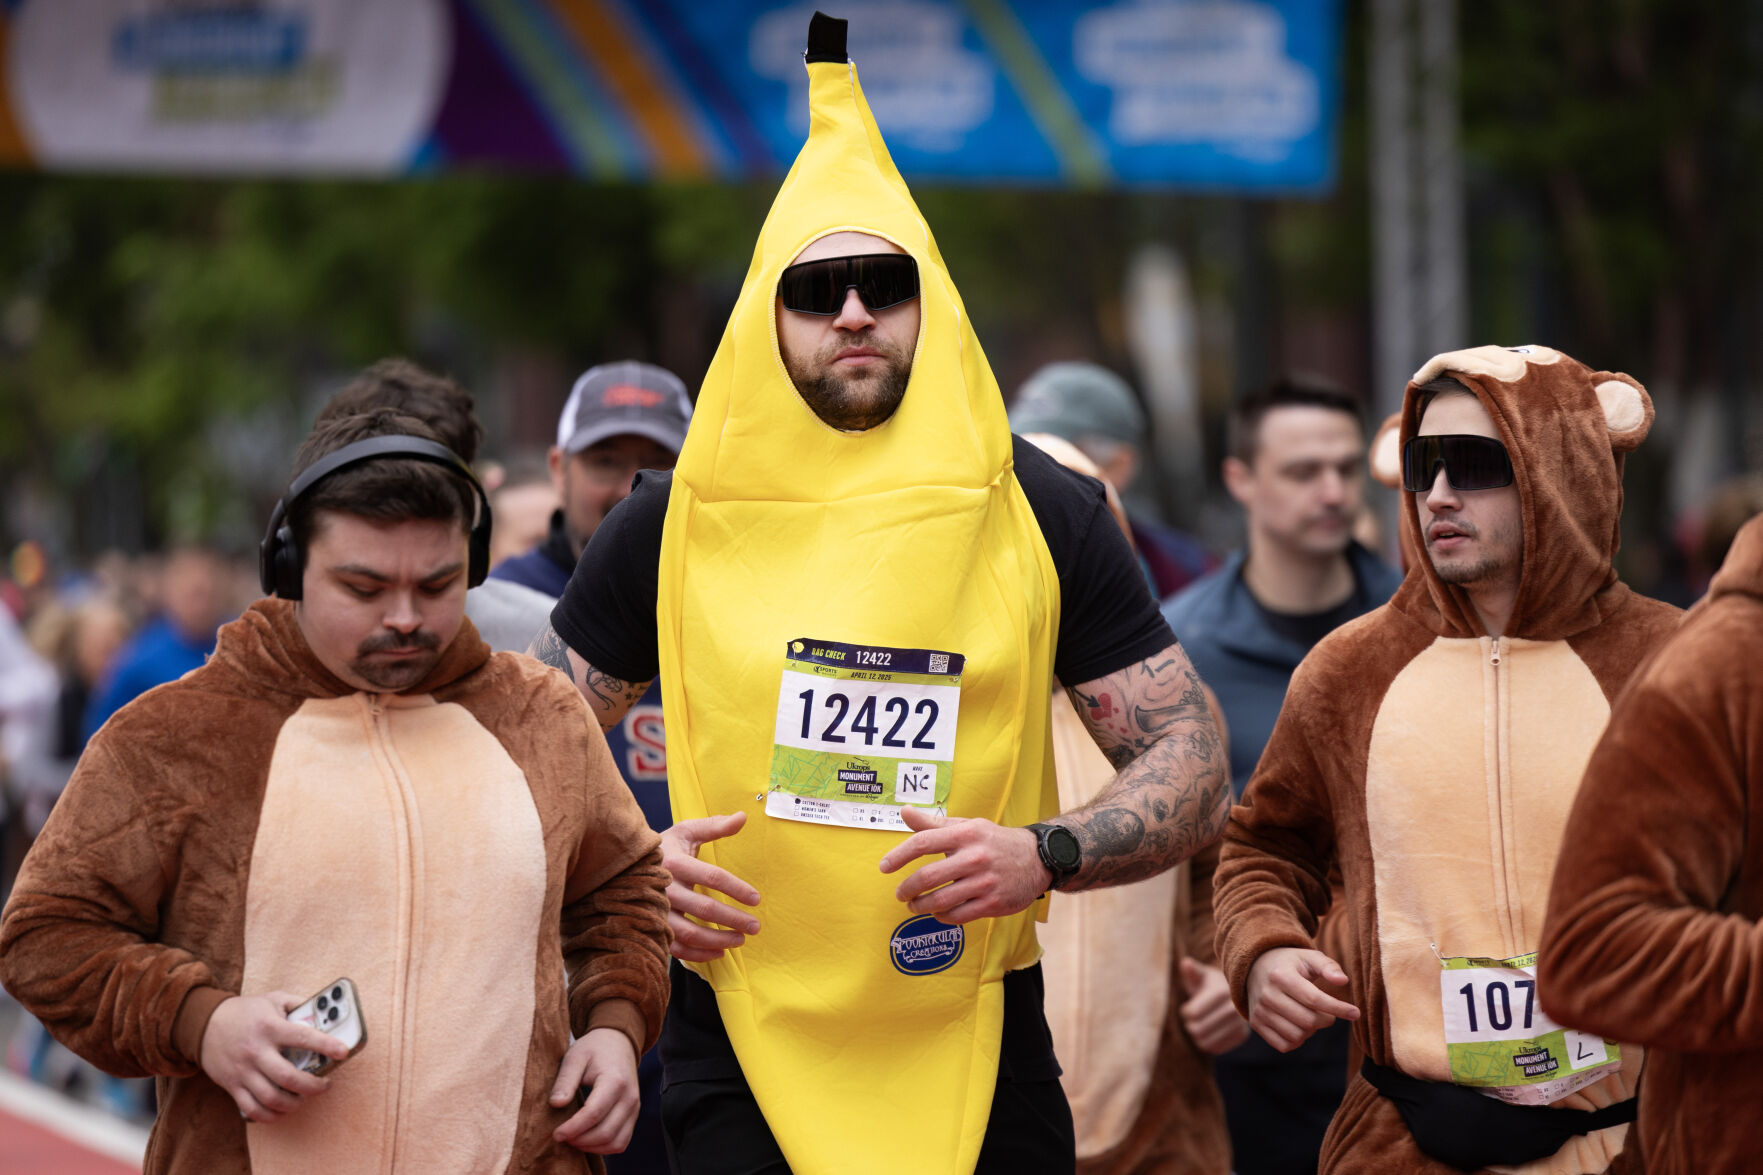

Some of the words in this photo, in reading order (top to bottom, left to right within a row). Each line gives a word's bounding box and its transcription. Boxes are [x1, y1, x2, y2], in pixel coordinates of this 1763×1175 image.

[812, 647, 824, 657] BAG
[825, 649, 847, 661] CHECK
[856, 650, 892, 666] 12422
[851, 671, 867, 680] APRIL
[877, 673, 892, 681] 2025
[799, 688, 940, 750] 12422
[839, 771, 874, 782] MONUMENT
[903, 773, 930, 793] NC
[847, 783, 870, 793] AVENUE
[870, 784, 882, 793] 10K
[1459, 979, 1536, 1032] 107
[1515, 1051, 1548, 1065] MONUMENT
[1525, 1063, 1547, 1075] AVENUE
